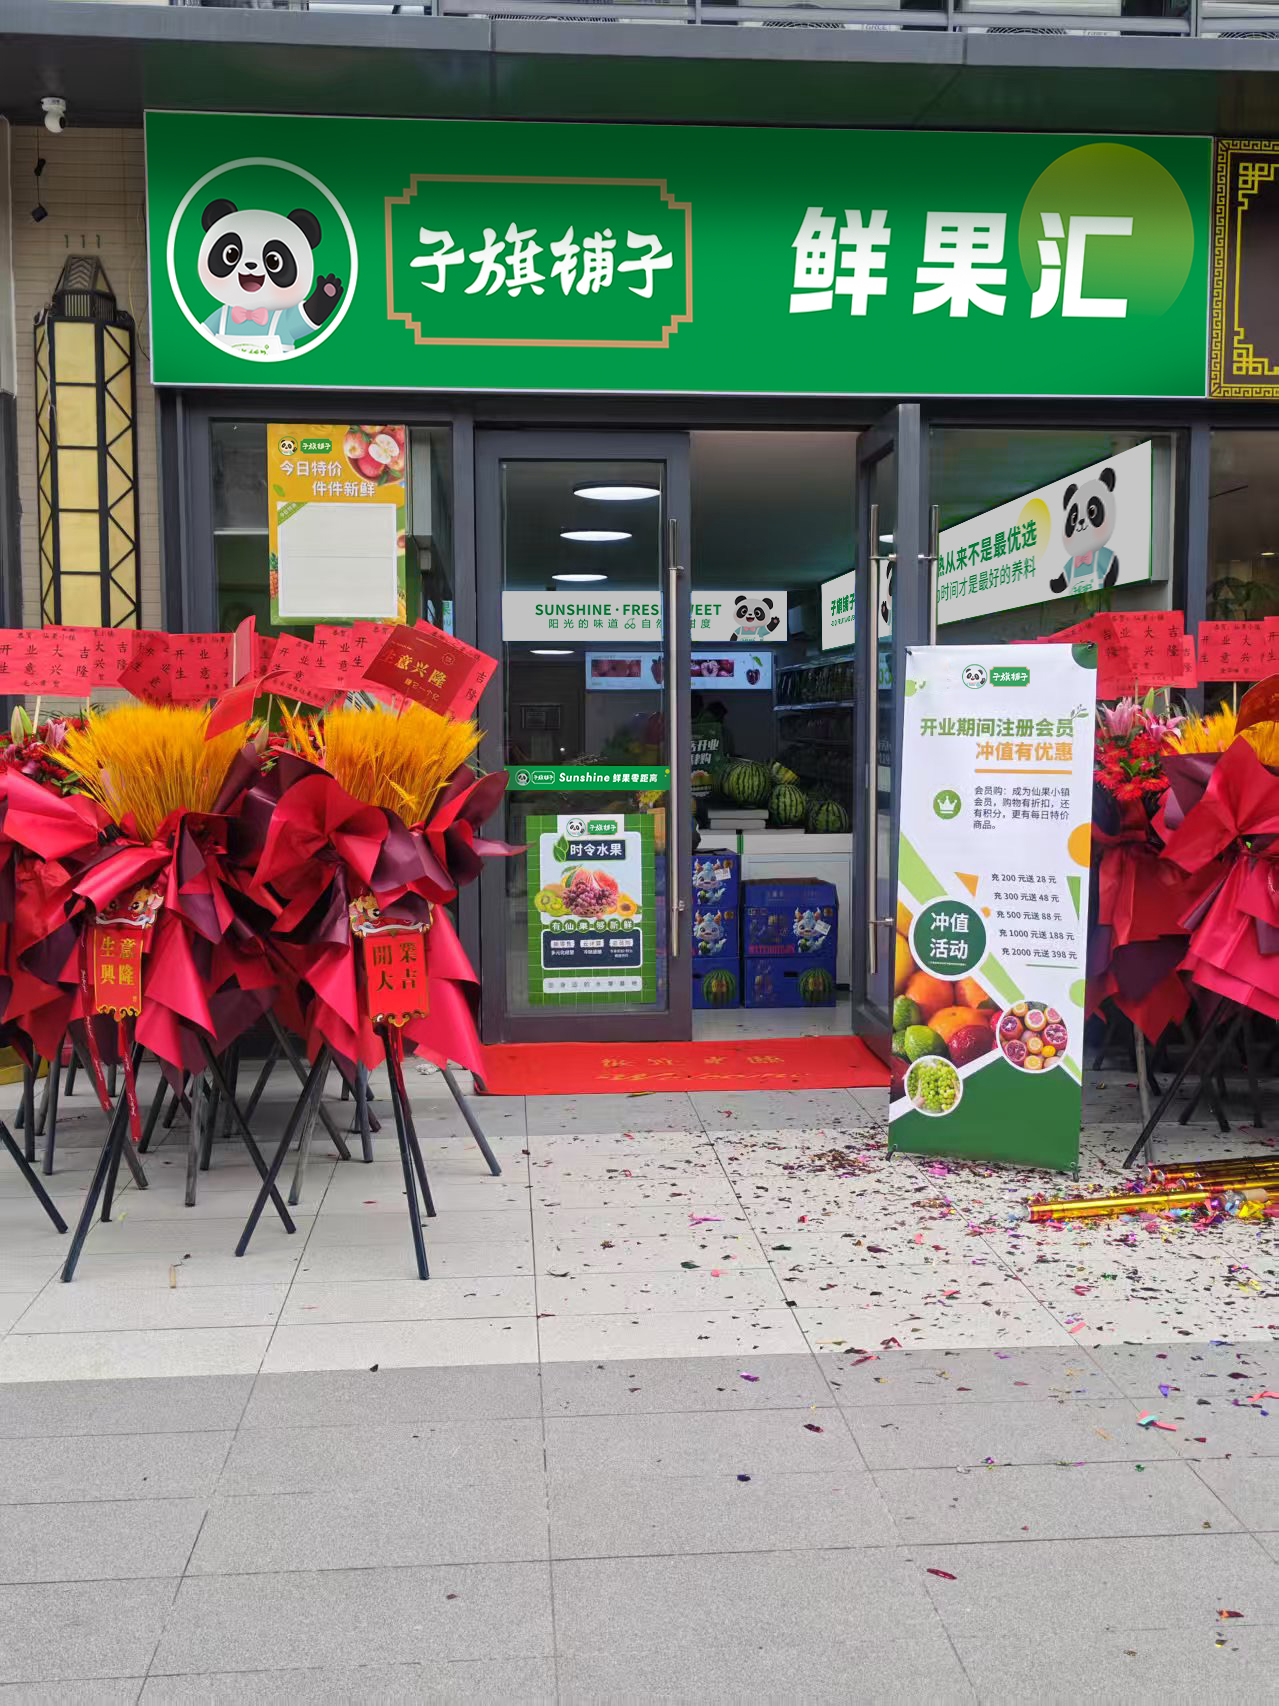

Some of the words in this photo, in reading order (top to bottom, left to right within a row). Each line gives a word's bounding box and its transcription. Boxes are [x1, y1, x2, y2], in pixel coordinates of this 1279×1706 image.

[409, 221, 674, 298] 子旗铺子
[789, 206, 1133, 318] 鲜果汇
[280, 460, 343, 477] 今日特价
[312, 481, 376, 497] 件件新鲜
[623, 604, 662, 616] FRES
[548, 619, 619, 629] 阳光的味道
[920, 717, 1074, 738] 开业期间注册会员
[976, 741, 1073, 762] 冲值有优惠
[559, 771, 610, 783] Sunshine
[570, 843, 622, 857] 时令水果
[930, 912, 969, 933] 冲值
[930, 938, 968, 960] 活动
